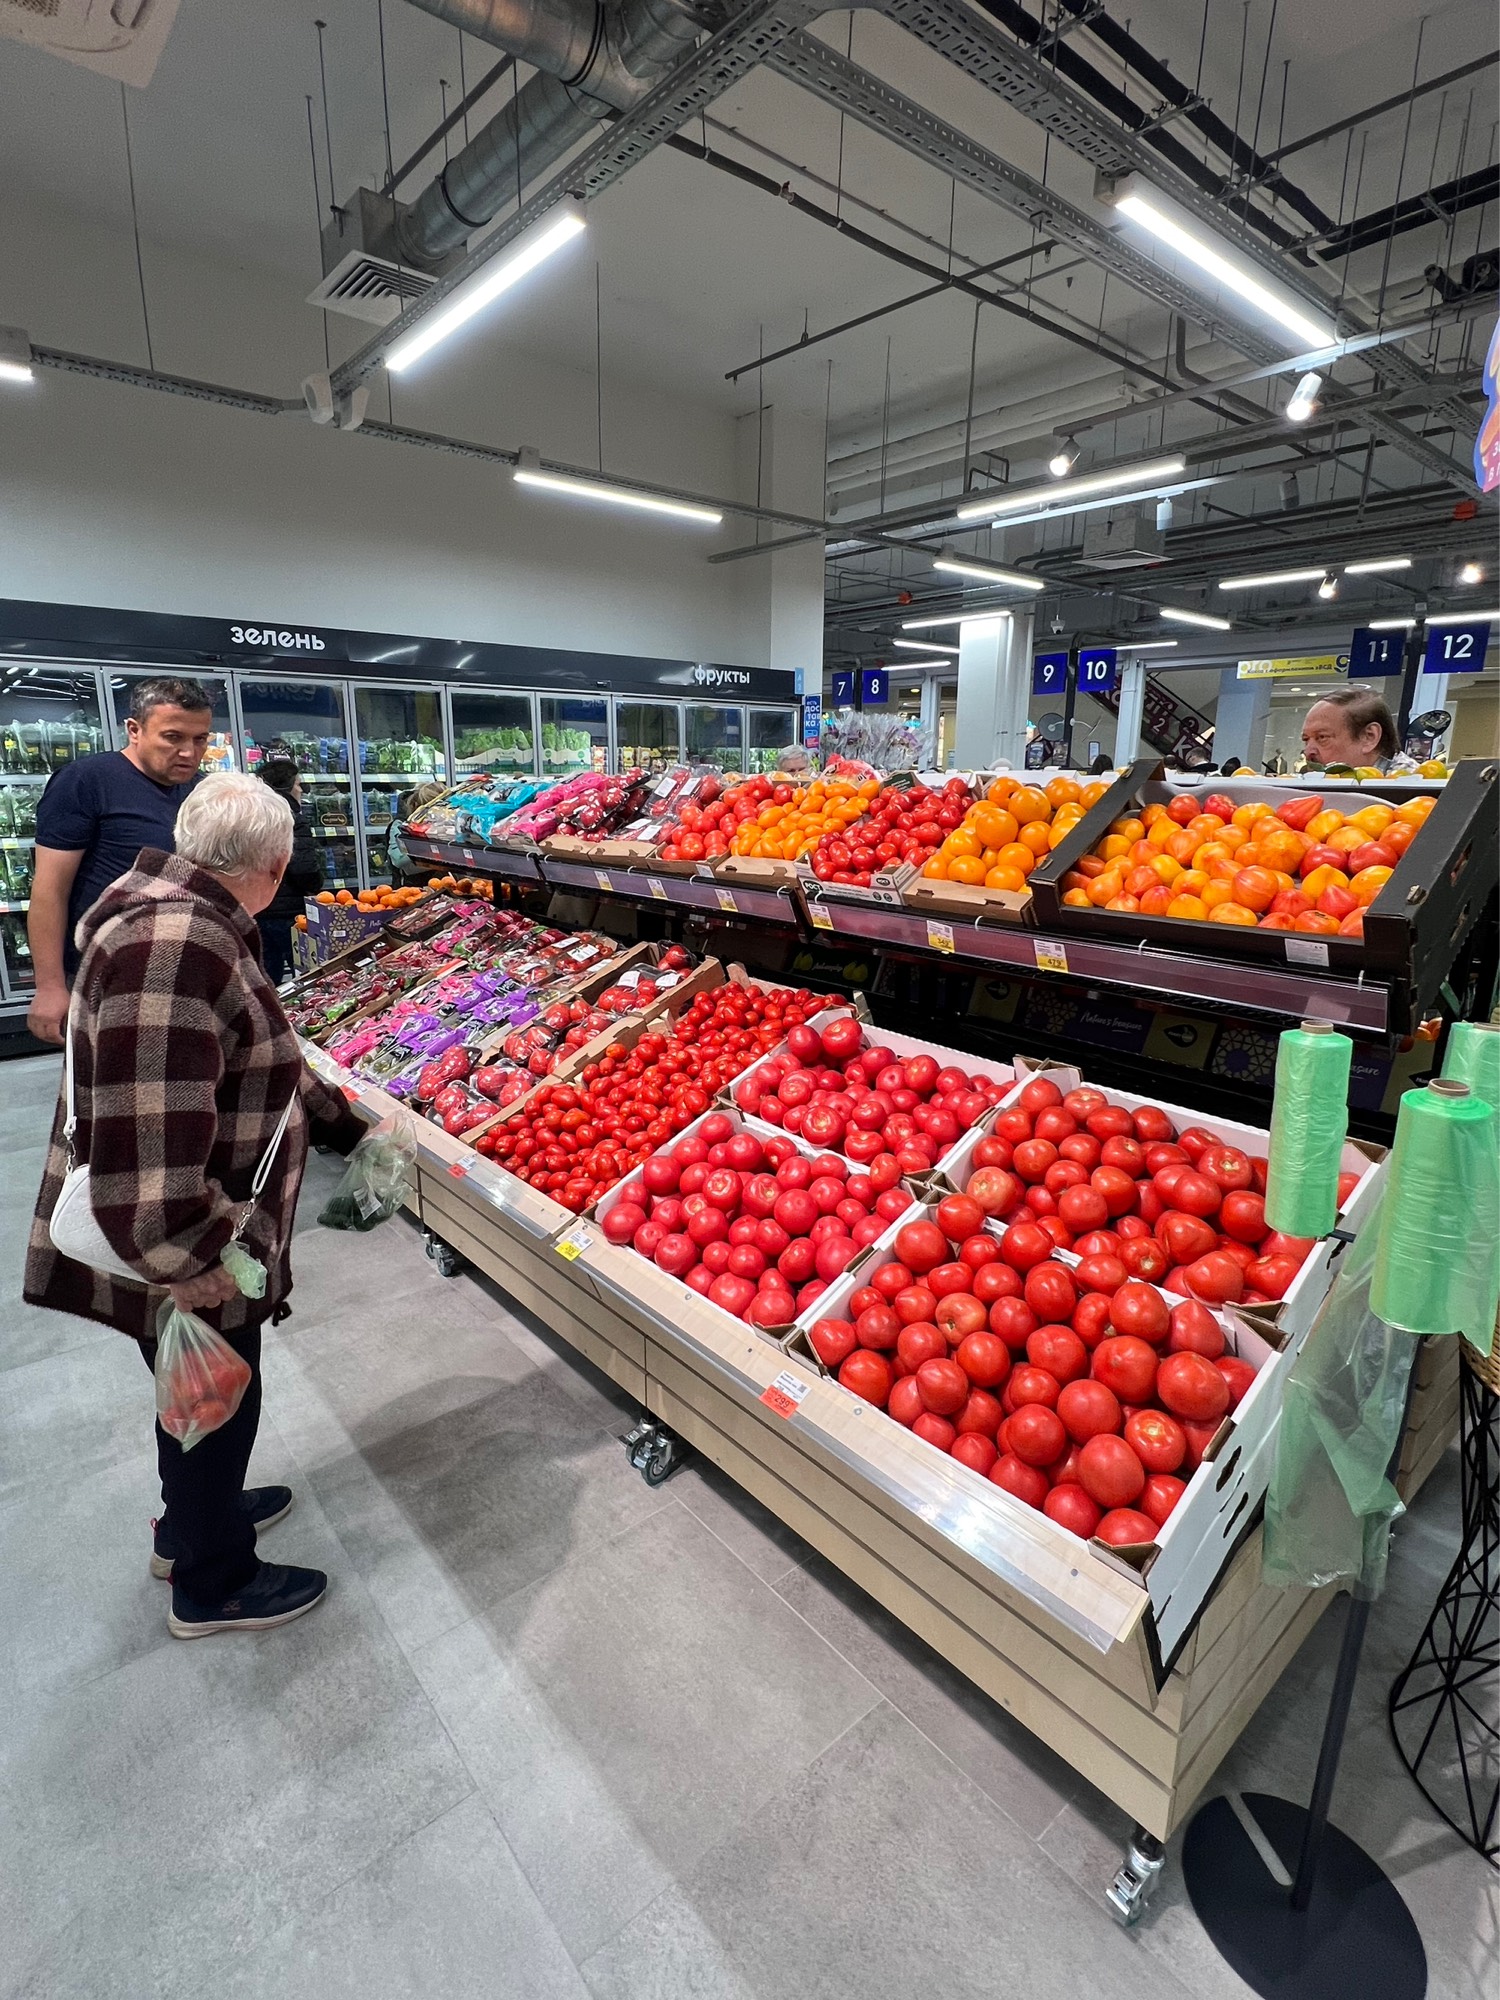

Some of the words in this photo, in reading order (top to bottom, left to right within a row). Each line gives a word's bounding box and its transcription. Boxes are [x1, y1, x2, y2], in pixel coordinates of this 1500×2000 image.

[230, 626, 326, 651] зелень
[1442, 633, 1475, 660] 12
[1367, 639, 1389, 662] 11
[694, 664, 751, 686] фрукты
[1043, 663, 1055, 683] 9
[1086, 661, 1107, 680] 10
[837, 681, 846, 697] 7
[870, 678, 880, 695] 8
[774, 1394, 791, 1408] 299
